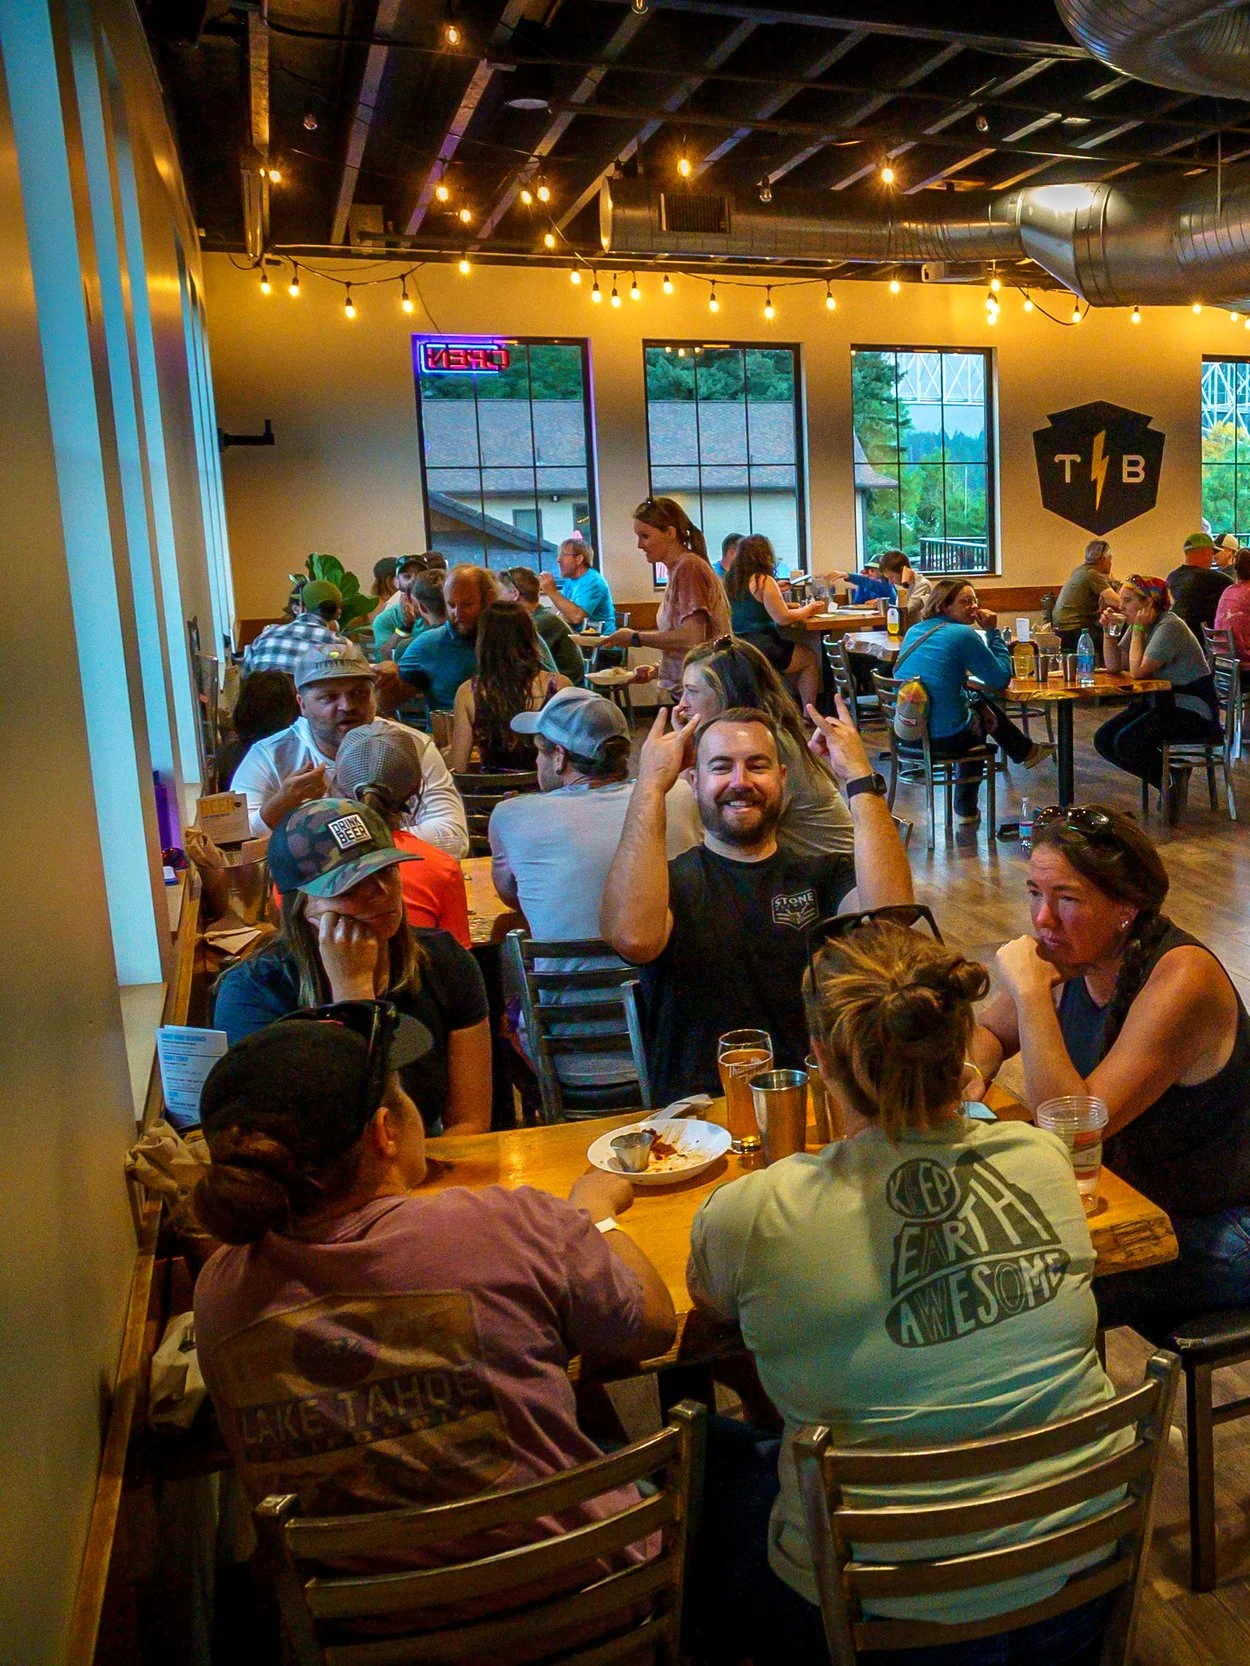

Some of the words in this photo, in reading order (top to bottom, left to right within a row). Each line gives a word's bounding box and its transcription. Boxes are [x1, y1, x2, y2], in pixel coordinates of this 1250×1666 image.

[1053, 453, 1082, 484] T
[1122, 454, 1146, 484] B
[331, 815, 362, 834] DRINK
[336, 825, 368, 844] BEER
[774, 892, 814, 908] STONE
[889, 1161, 952, 1216] KEEP
[897, 1162, 1052, 1289] EARTH
[899, 1252, 1063, 1345] AWESOME
[241, 1399, 325, 1444] LAKE
[337, 1366, 481, 1429] TAHOE
